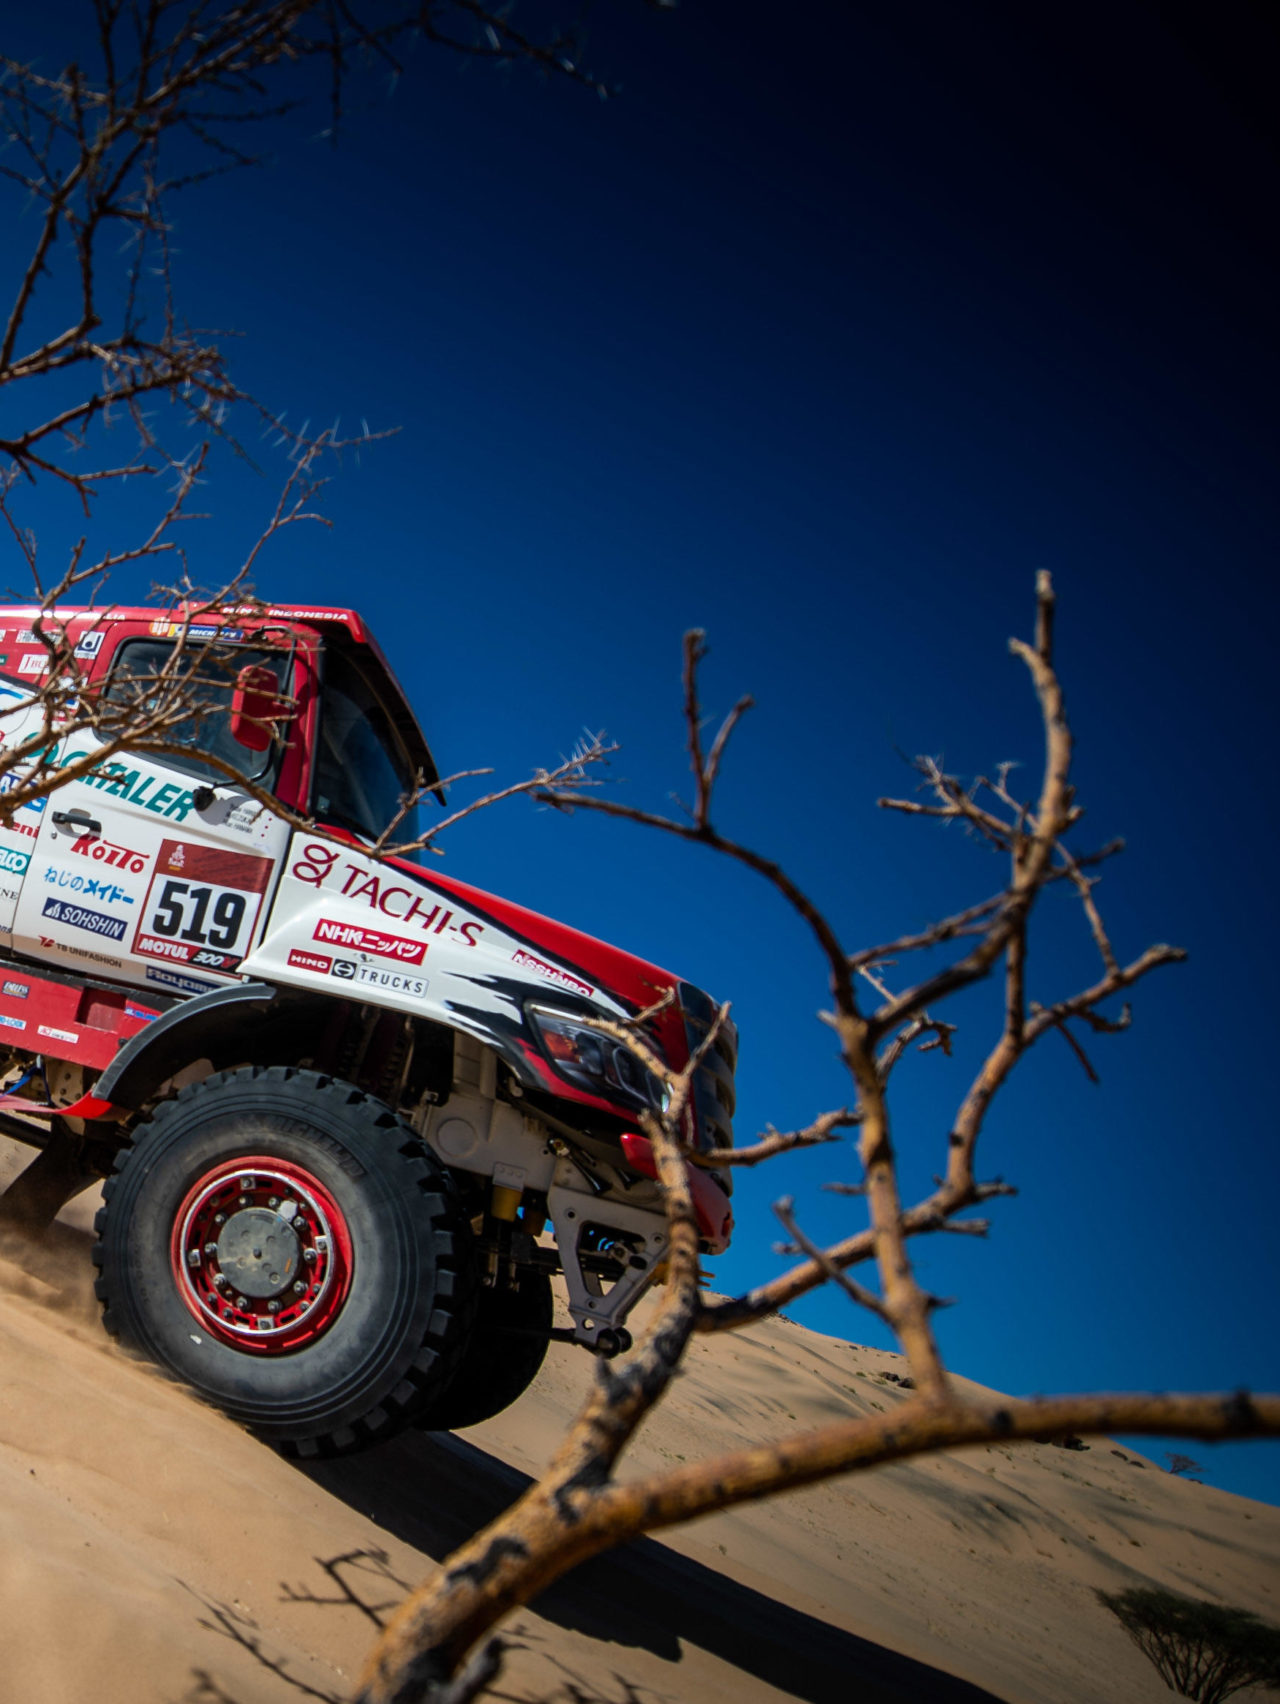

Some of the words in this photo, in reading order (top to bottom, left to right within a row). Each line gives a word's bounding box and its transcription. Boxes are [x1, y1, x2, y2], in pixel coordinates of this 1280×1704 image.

[268, 609, 349, 621] INDONESIA
[43, 865, 135, 905] ねじのメイドー
[152, 879, 247, 950] 519
[339, 863, 486, 948] TACHI-S
[61, 906, 125, 938] SOHSHIN
[68, 944, 122, 968] UNIFASHION
[139, 938, 189, 960] MOTUL
[193, 951, 241, 969] 300V
[290, 953, 329, 971] HINO
[360, 968, 424, 994] TRUCKS
